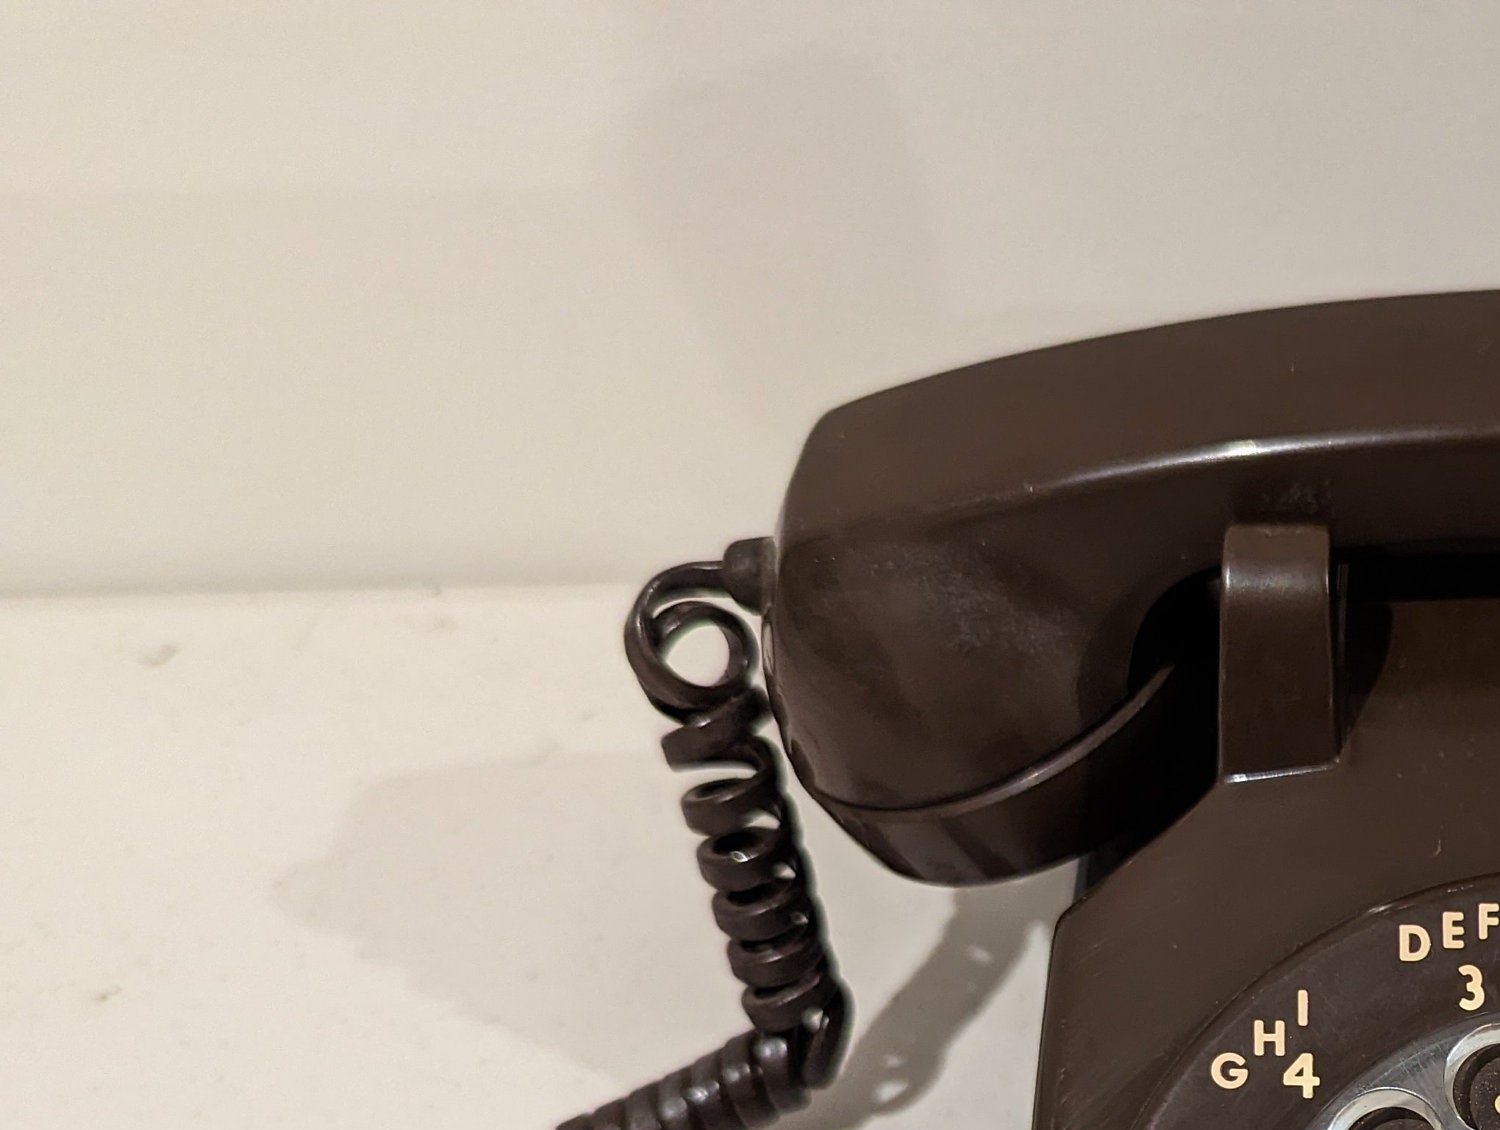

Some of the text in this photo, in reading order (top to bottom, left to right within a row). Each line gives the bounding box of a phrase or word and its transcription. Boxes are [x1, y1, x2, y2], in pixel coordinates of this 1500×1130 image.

[1398, 902, 1500, 962] DEF
[1457, 964, 1485, 1011] 3
[1282, 1052, 1321, 1099] 4
